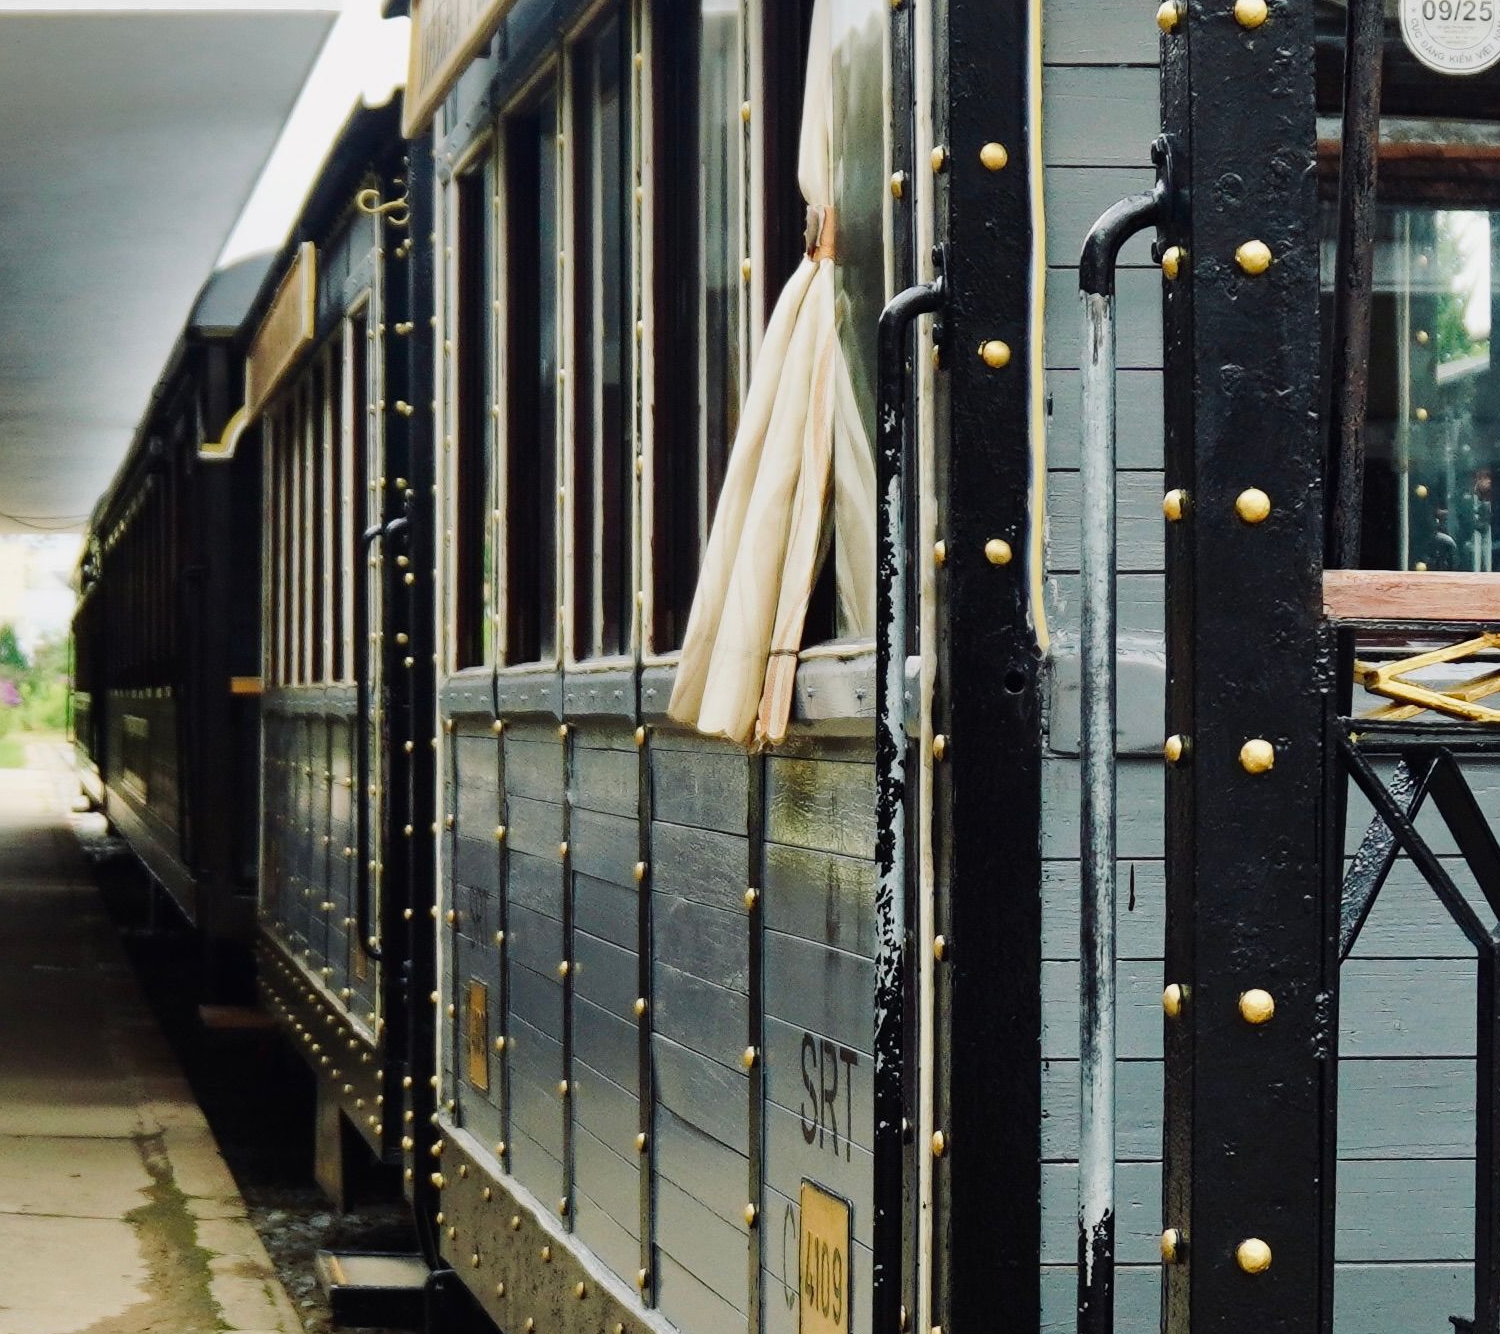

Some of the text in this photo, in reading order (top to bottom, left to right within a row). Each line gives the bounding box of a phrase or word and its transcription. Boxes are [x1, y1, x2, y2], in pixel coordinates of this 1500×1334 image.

[801, 1031, 858, 1163] SRT
[783, 1202, 843, 1327] C 4109
